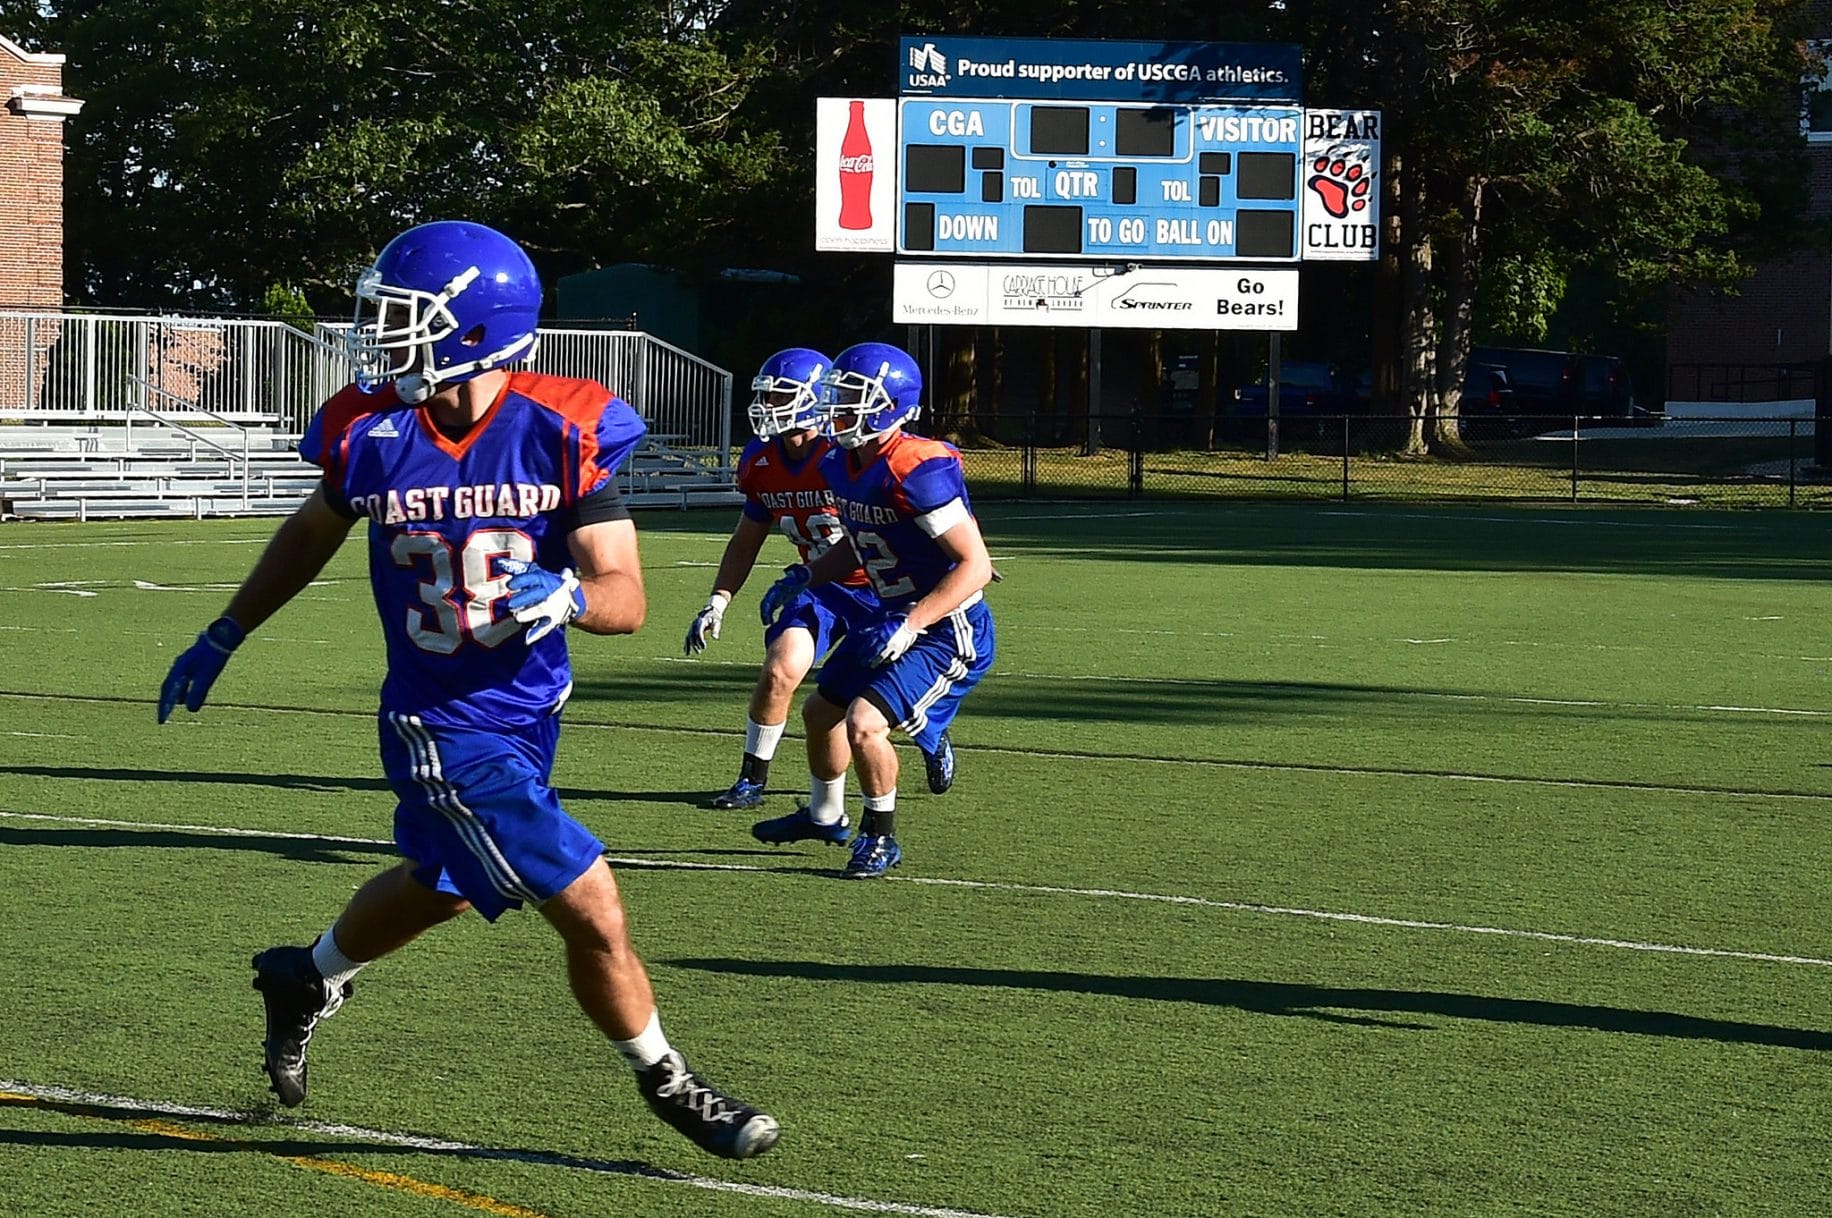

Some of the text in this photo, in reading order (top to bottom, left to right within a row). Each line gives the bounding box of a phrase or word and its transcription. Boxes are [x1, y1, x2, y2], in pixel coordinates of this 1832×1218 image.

[909, 74, 947, 87] USAA
[958, 59, 1289, 83] Proud supporter of USCGA athletics.
[928, 109, 985, 137] CGA
[1201, 116, 1297, 143] VISITOR
[1305, 114, 1379, 140] BEAR
[1010, 177, 1042, 198] TOL
[1055, 171, 1098, 200] QTR
[1161, 180, 1192, 202] TOL
[939, 214, 999, 241] DOWN
[1087, 218, 1145, 245] TO GO
[1155, 221, 1233, 247] BALL ON
[1308, 224, 1377, 248] CLUB
[1237, 278, 1265, 294] Go
[902, 304, 979, 316] Mercedes-Benz
[1216, 299, 1285, 316] Bears!
[454, 484, 562, 520] GUARD
[758, 492, 793, 508] OAST
[795, 489, 836, 509] GUAR
